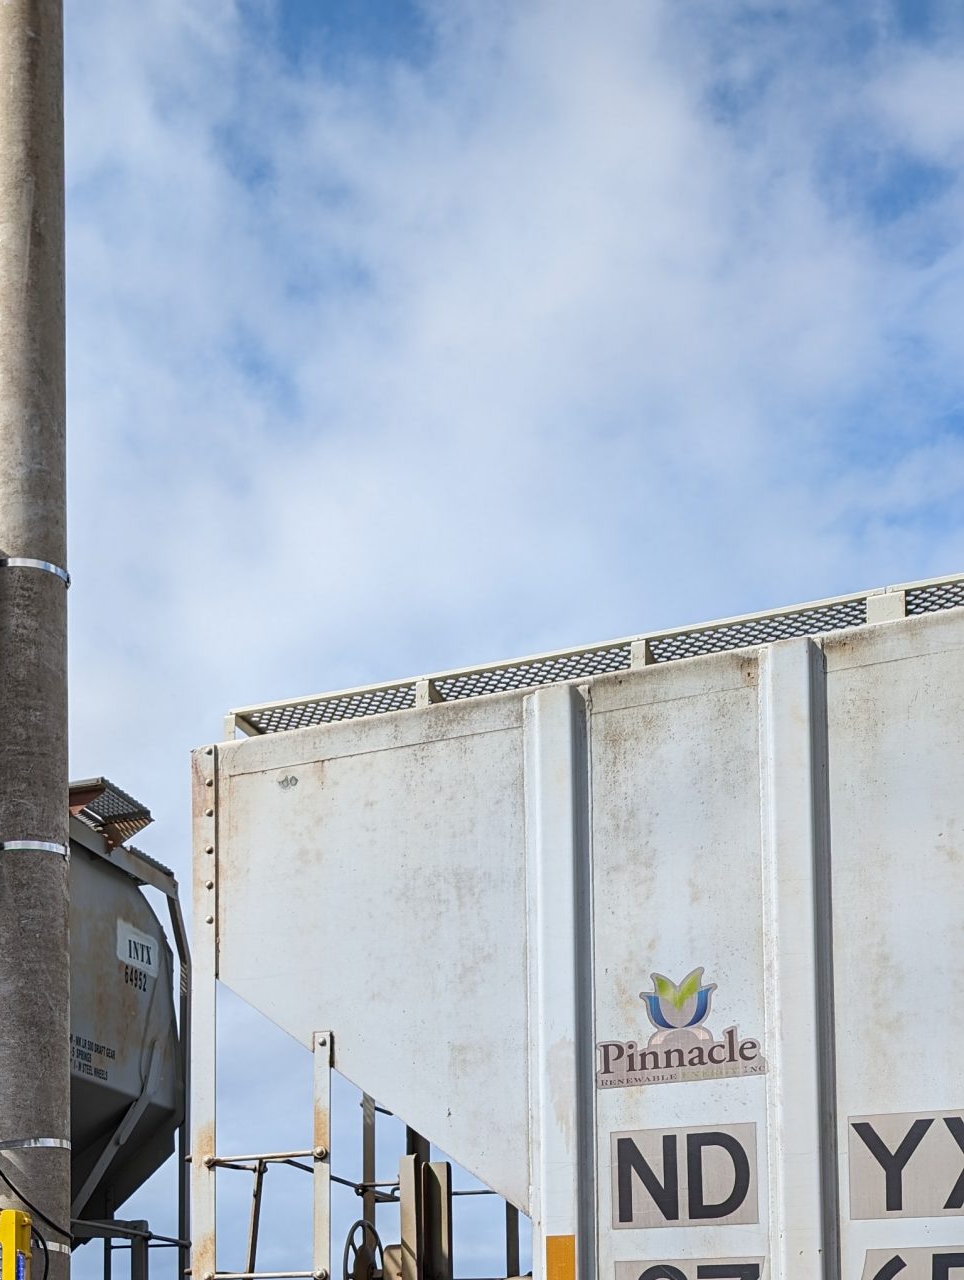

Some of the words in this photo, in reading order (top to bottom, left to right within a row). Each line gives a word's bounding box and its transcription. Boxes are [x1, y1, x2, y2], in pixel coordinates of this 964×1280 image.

[128, 939, 152, 965] INTX
[125, 964, 147, 992] 64952
[600, 1028, 758, 1075] Pinnacle
[601, 1074, 677, 1087] RENEWABLE
[617, 1132, 750, 1223] ND
